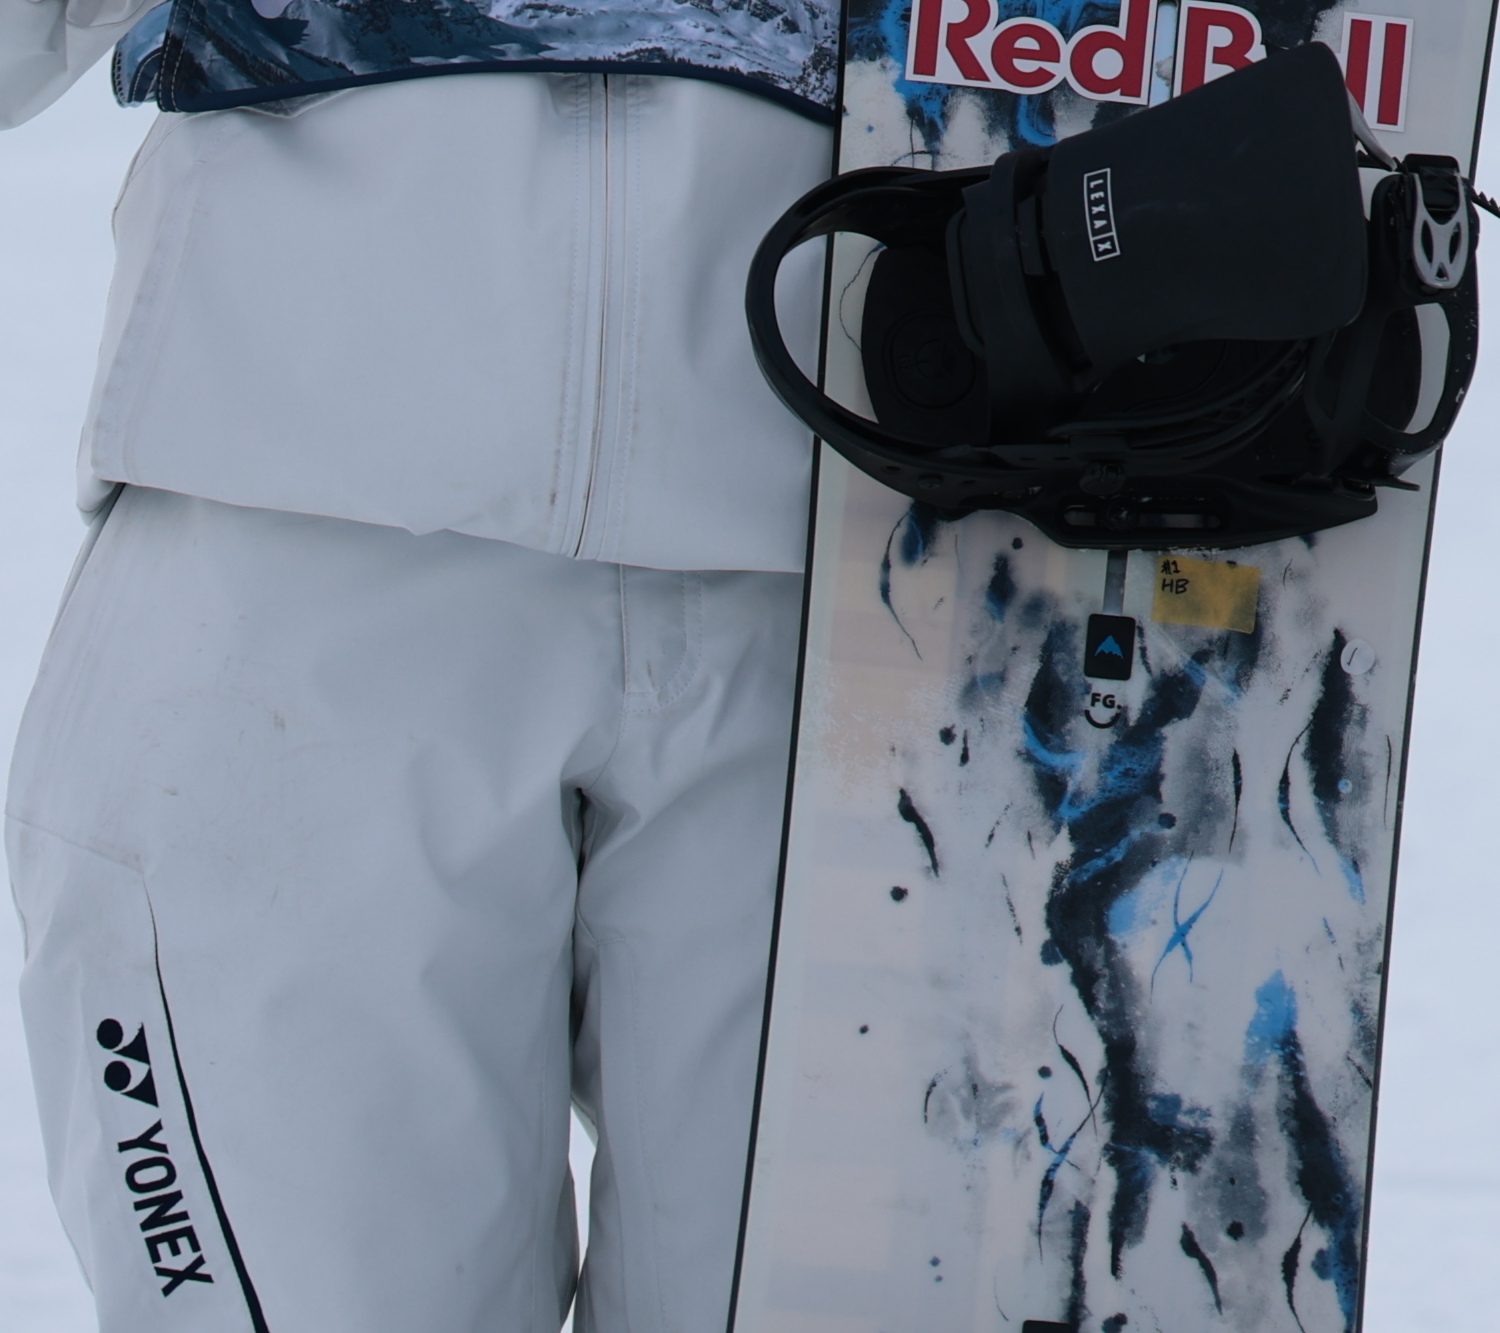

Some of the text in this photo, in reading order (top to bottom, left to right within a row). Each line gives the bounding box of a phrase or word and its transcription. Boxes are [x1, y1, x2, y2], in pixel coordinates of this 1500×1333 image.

[1182, 5, 1408, 126] Bll
[1090, 179, 1112, 252] LEXA X
[1160, 578, 1190, 595] HB
[117, 1118, 214, 1298] YONEX
